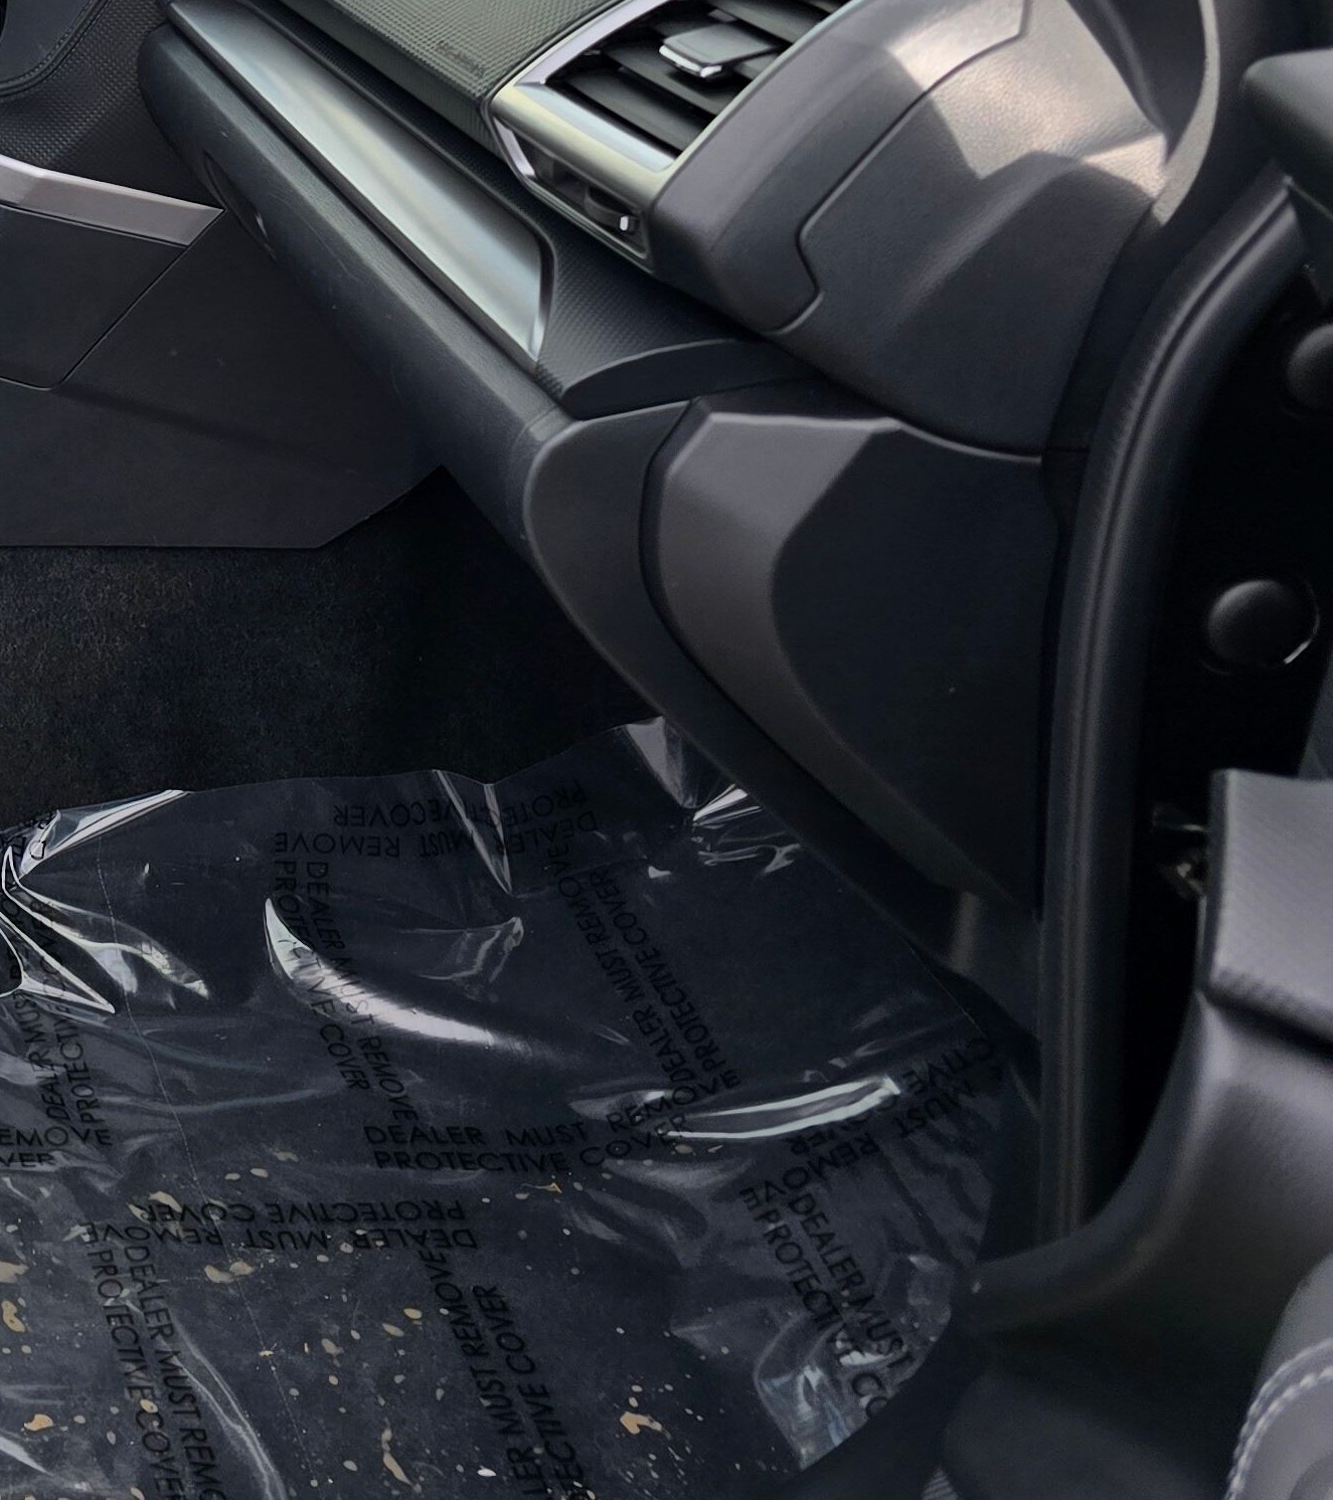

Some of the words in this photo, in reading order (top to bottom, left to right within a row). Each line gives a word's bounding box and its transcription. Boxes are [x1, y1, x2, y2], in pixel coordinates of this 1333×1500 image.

[274, 832, 401, 858] REMOVE
[306, 861, 346, 951] DEALER
[356, 1035, 419, 1123] REMOVE
[595, 949, 645, 1003] MUST
[635, 947, 727, 1074] PROTECTIVE
[319, 1023, 371, 1091] COVER
[633, 1004, 697, 1084] DEALER
[363, 1123, 487, 1147] DEALER
[505, 1122, 585, 1149] MUST
[606, 1070, 741, 1132] REMOVE
[373, 1149, 568, 1174] PROTECTIVE
[245, 1228, 330, 1251] MUST
[268, 1199, 467, 1225] PROTECTIVE
[351, 1226, 479, 1250] DEALER
[786, 1192, 866, 1295] DEALER
[123, 1245, 175, 1342] DEALER
[156, 1349, 201, 1420] MUST
[471, 1284, 537, 1376] COVER
[469, 1364, 526, 1437] MUST
